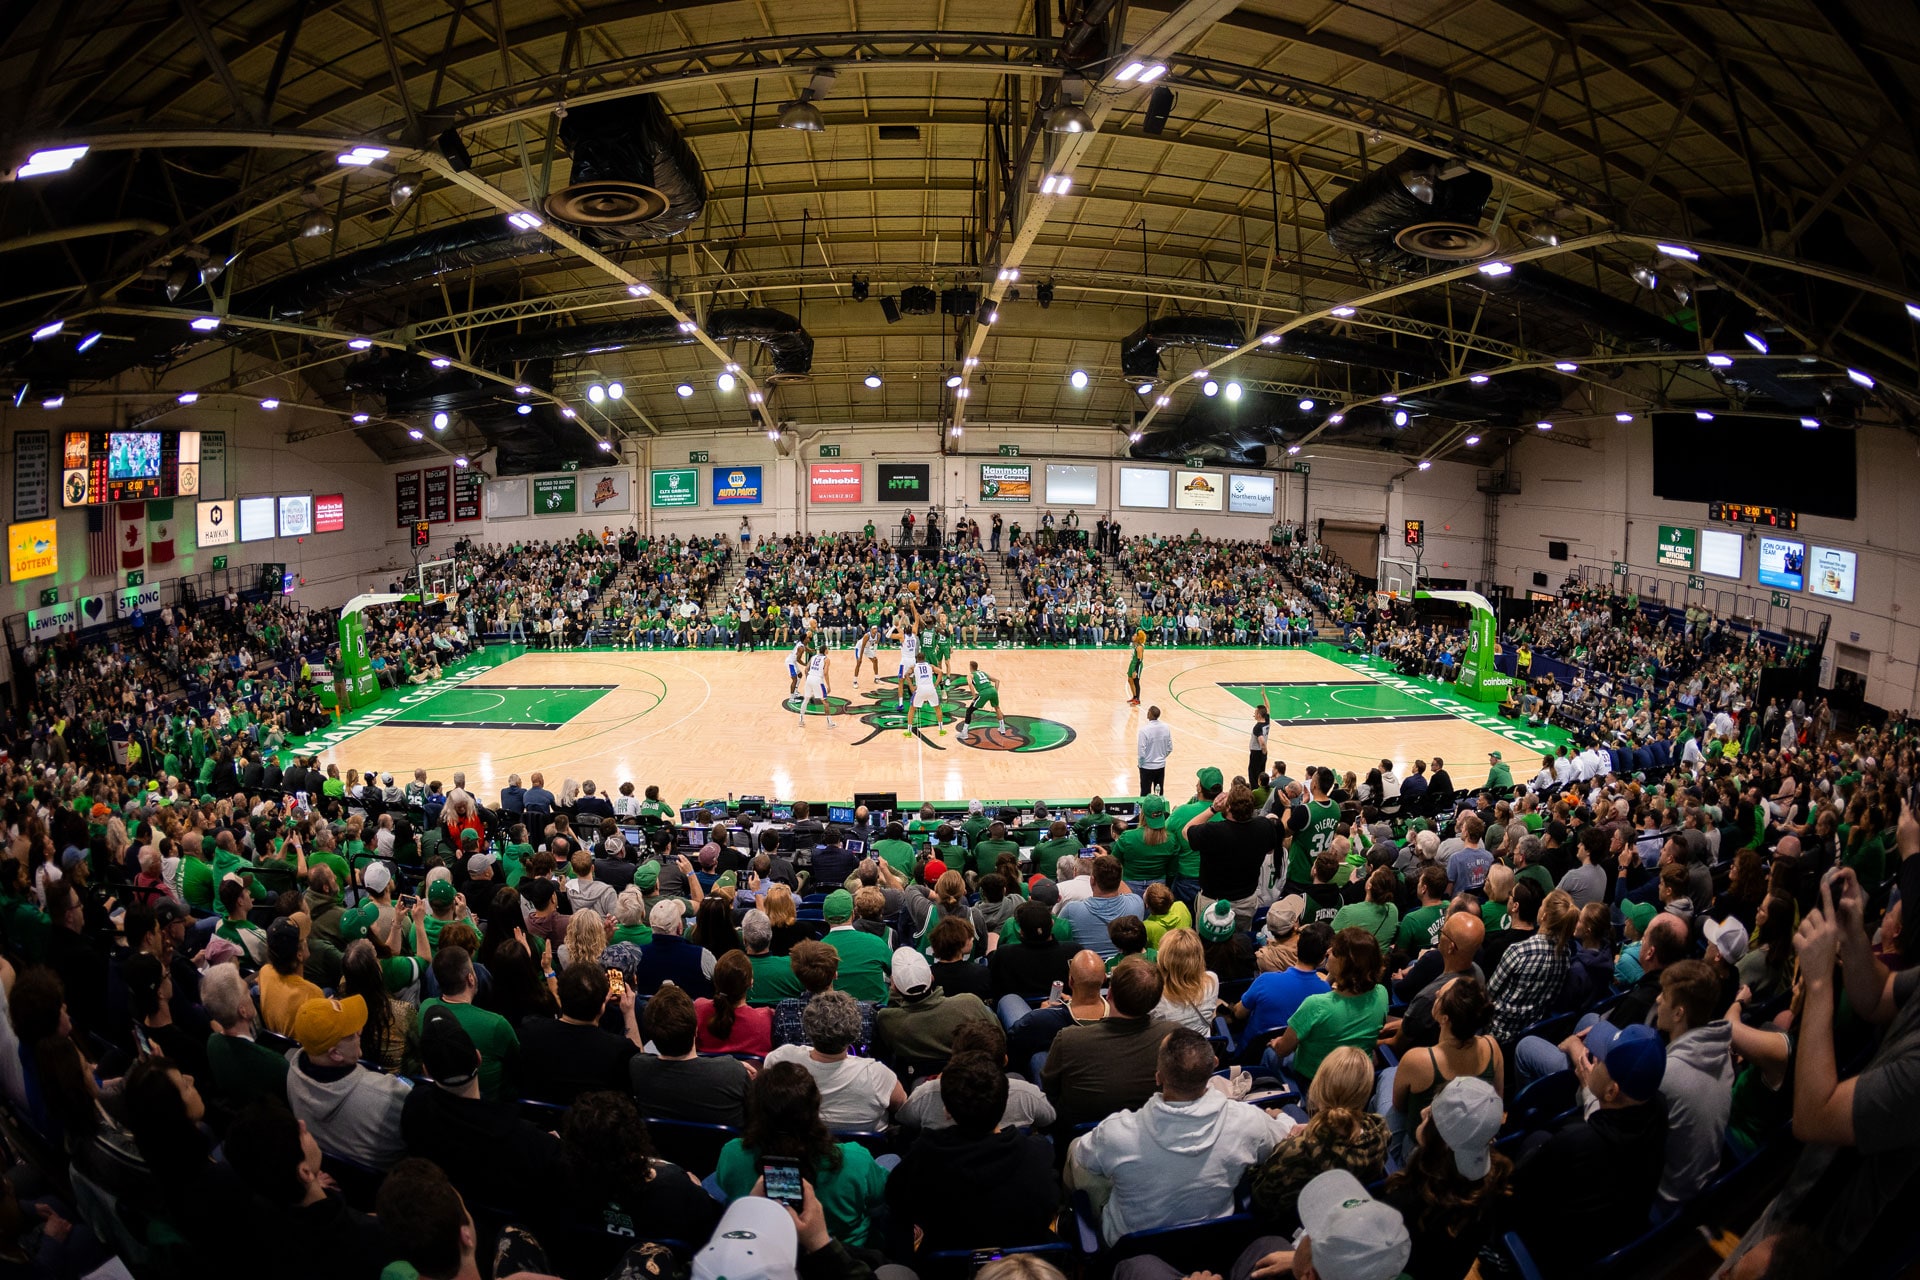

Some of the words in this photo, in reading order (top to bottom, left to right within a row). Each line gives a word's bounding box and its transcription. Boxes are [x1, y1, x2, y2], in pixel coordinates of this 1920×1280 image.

[830, 448, 838, 456] 11
[1008, 449, 1018, 457] 12
[698, 454, 707, 462] 10
[983, 465, 1029, 474] Hammond
[812, 477, 859, 485] Mainebiz
[888, 479, 919, 489] HYPE
[718, 489, 736, 497] AUTO
[737, 488, 757, 496] PARTS
[288, 514, 304, 524] DINER
[205, 529, 229, 539] HAWKIN
[417, 531, 427, 545] 24
[1408, 530, 1418, 543] 24
[1659, 543, 1675, 552] MAINE
[1676, 546, 1692, 554] CELTICS
[1666, 551, 1685, 560] OFFICIAL
[17, 557, 52, 572] LOTTERY
[1659, 557, 1691, 568] MERCHANDISE
[1619, 566, 1627, 574] 15
[1695, 581, 1703, 589] 16
[119, 591, 159, 609] STRONG
[1779, 597, 1788, 607] 17
[31, 611, 74, 631] LEWISTON
[919, 665, 928, 674] 18
[399, 666, 492, 703] CELTICS
[1342, 663, 1433, 696] MAINE
[1483, 678, 1513, 687] coinbase
[1429, 697, 1556, 750] CELTICS
[290, 707, 403, 756] MAINE
[1314, 818, 1338, 832] PIERCE
[1310, 830, 1335, 857] 34
